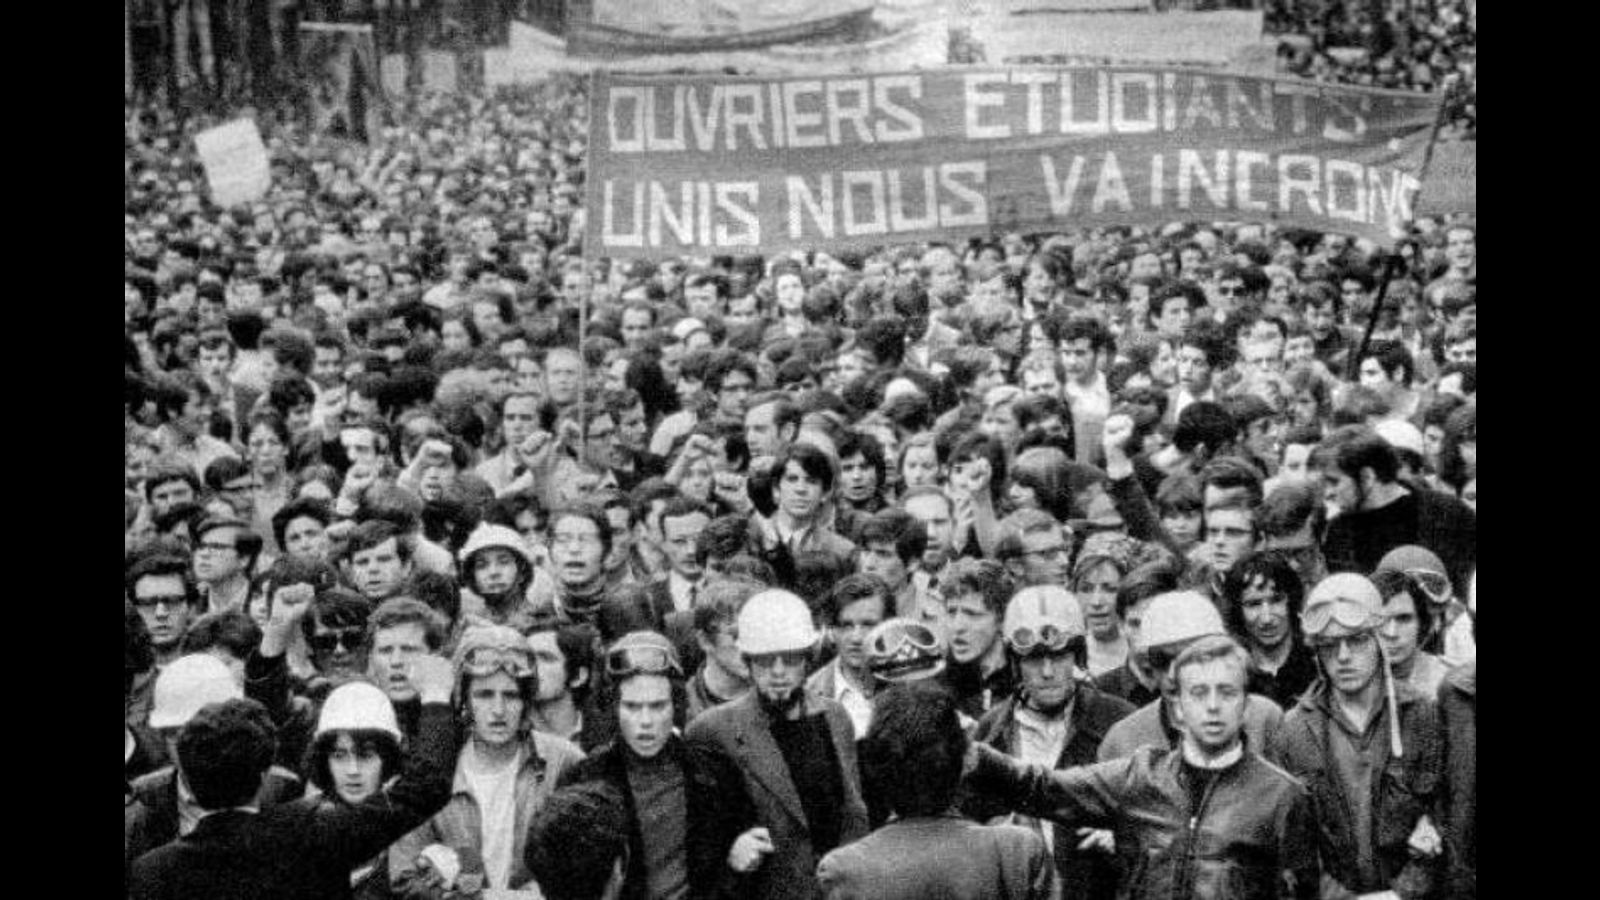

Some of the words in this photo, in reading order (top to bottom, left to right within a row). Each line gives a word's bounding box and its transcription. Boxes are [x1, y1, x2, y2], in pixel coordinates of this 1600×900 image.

[609, 75, 924, 151] OUVRIERS
[964, 72, 1368, 141] ETUDIANTS
[602, 180, 760, 247] UNIS
[786, 160, 988, 239] NOUS
